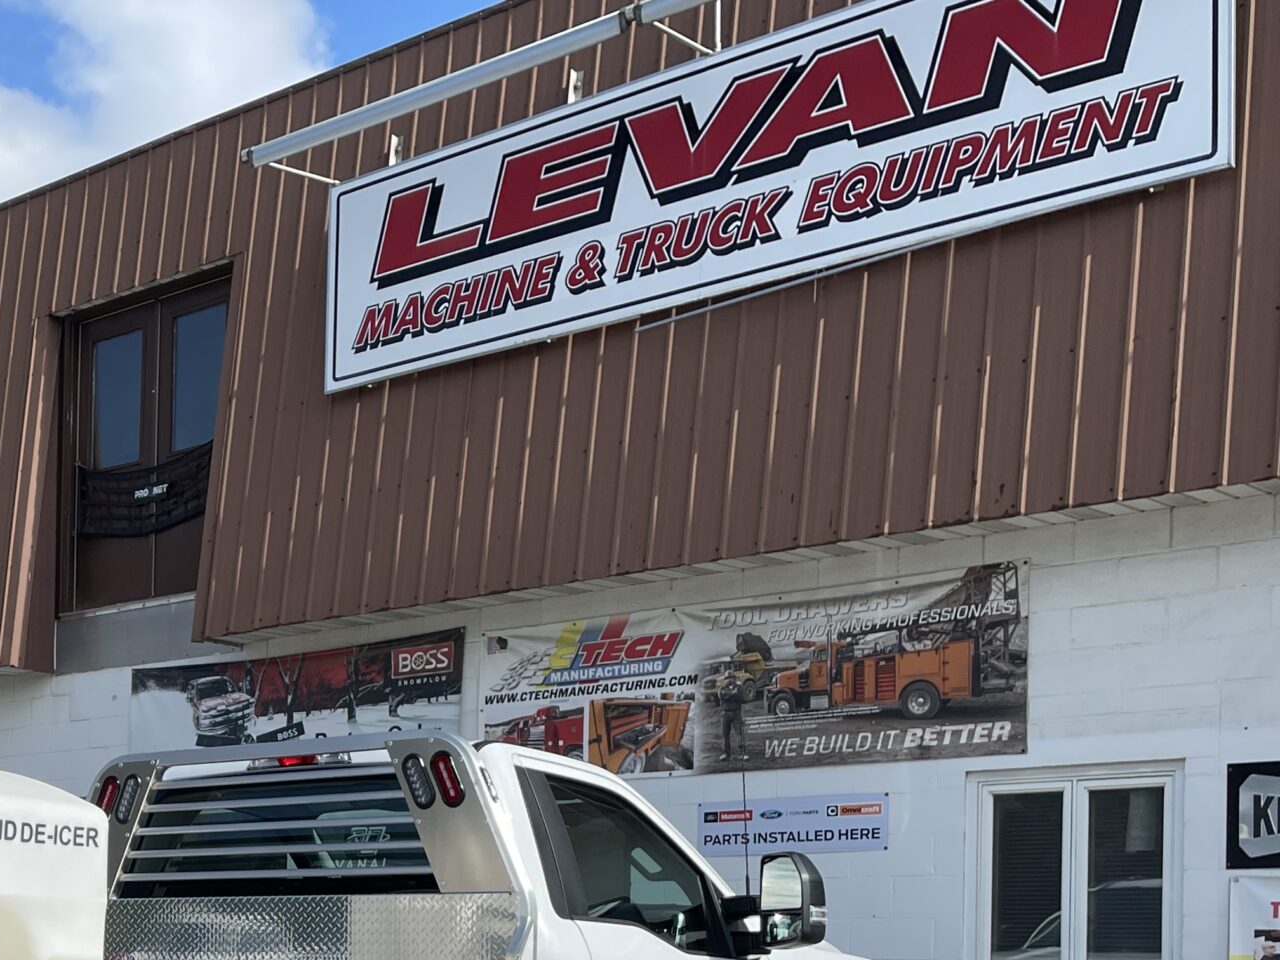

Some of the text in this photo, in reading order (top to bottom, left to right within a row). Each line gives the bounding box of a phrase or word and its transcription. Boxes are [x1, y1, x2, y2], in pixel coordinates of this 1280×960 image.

[370, 0, 1143, 290] LEVAN
[352, 76, 1183, 354] MACHINE & TRUCK EQUIPMENT
[707, 608, 767, 631] TOOL
[768, 599, 1014, 642] FOR WORKING PROFESSIONALS
[398, 648, 449, 673] BOSS
[550, 660, 663, 683] MANUFACTURING
[398, 675, 447, 687] SNOWPLOW
[484, 674, 699, 706] WWW.CTECHMANUFACTURING.COM
[276, 727, 298, 741] BOSS
[764, 721, 1012, 758] WE BUILD IT BETTER
[21, 822, 100, 849] DE-ICER
[703, 827, 881, 846] PARTS INSTALLED HERE
